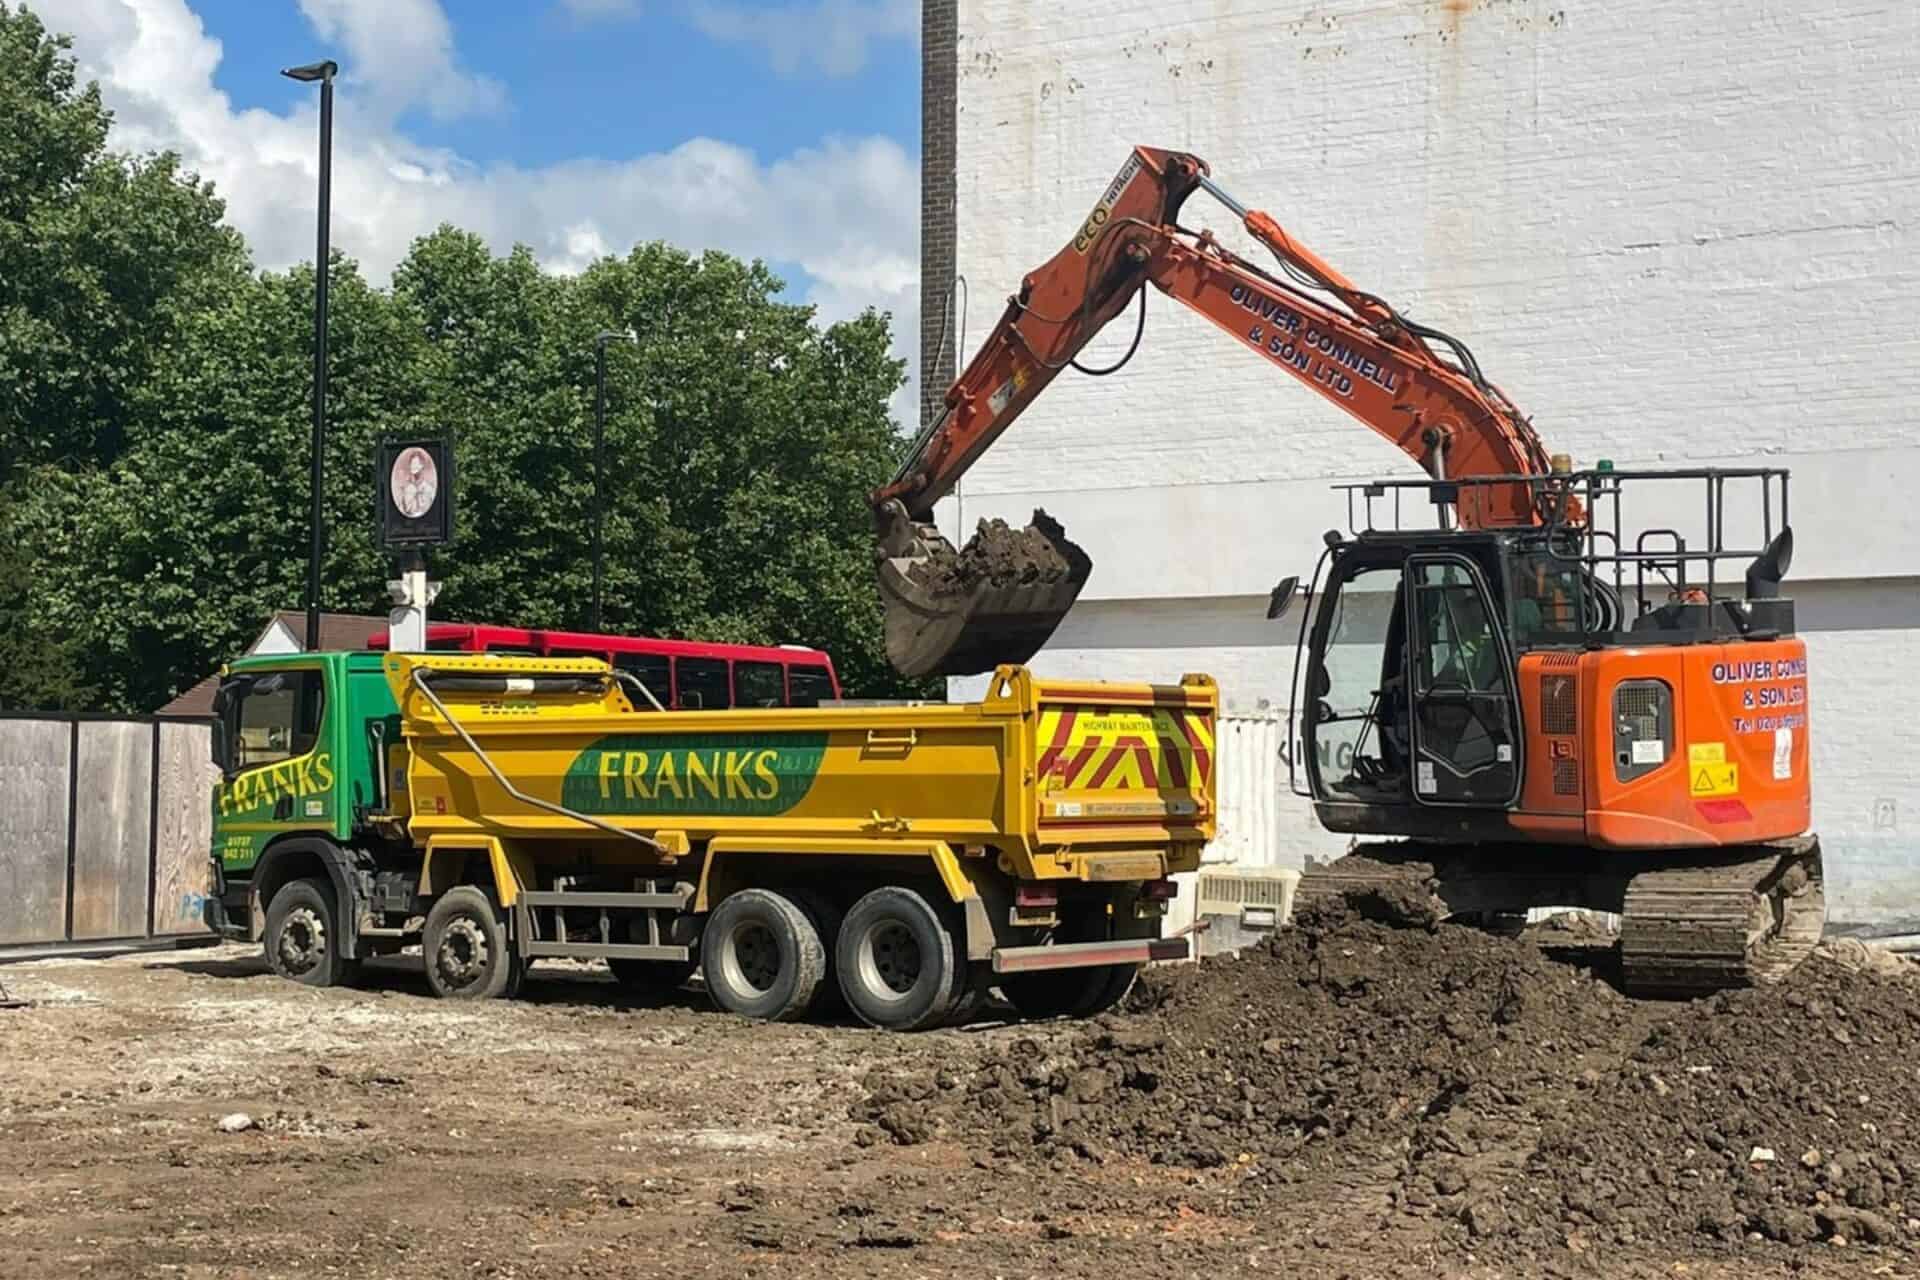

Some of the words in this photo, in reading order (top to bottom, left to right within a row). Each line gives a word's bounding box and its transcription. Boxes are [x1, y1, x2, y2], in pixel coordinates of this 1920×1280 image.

[1229, 285, 1301, 337] OLIVER
[1304, 327, 1398, 395] CONNELL
[1249, 326, 1265, 346] &
[1268, 335, 1312, 373] SON
[1712, 662, 1773, 684] OLIVER
[1743, 688, 1756, 709] &
[1759, 687, 1786, 708] SON
[599, 750, 779, 800] FRANKS
